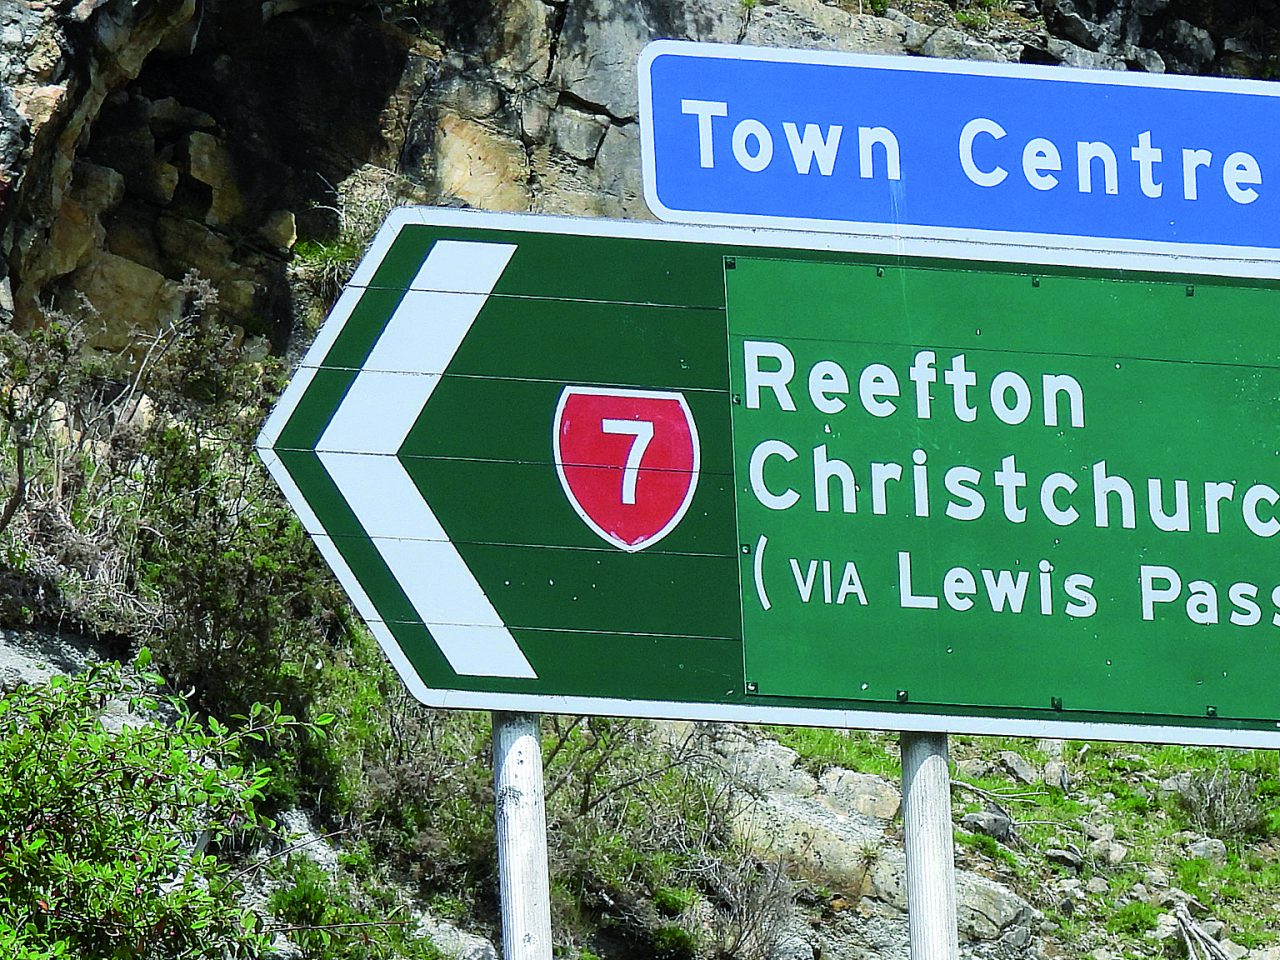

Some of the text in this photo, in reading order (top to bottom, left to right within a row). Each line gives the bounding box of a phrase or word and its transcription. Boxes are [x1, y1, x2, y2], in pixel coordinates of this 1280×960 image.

[681, 99, 1263, 204] Town Centre
[743, 340, 1085, 429] Reefton
[602, 418, 655, 505] 7
[898, 551, 1098, 618] Lewis
